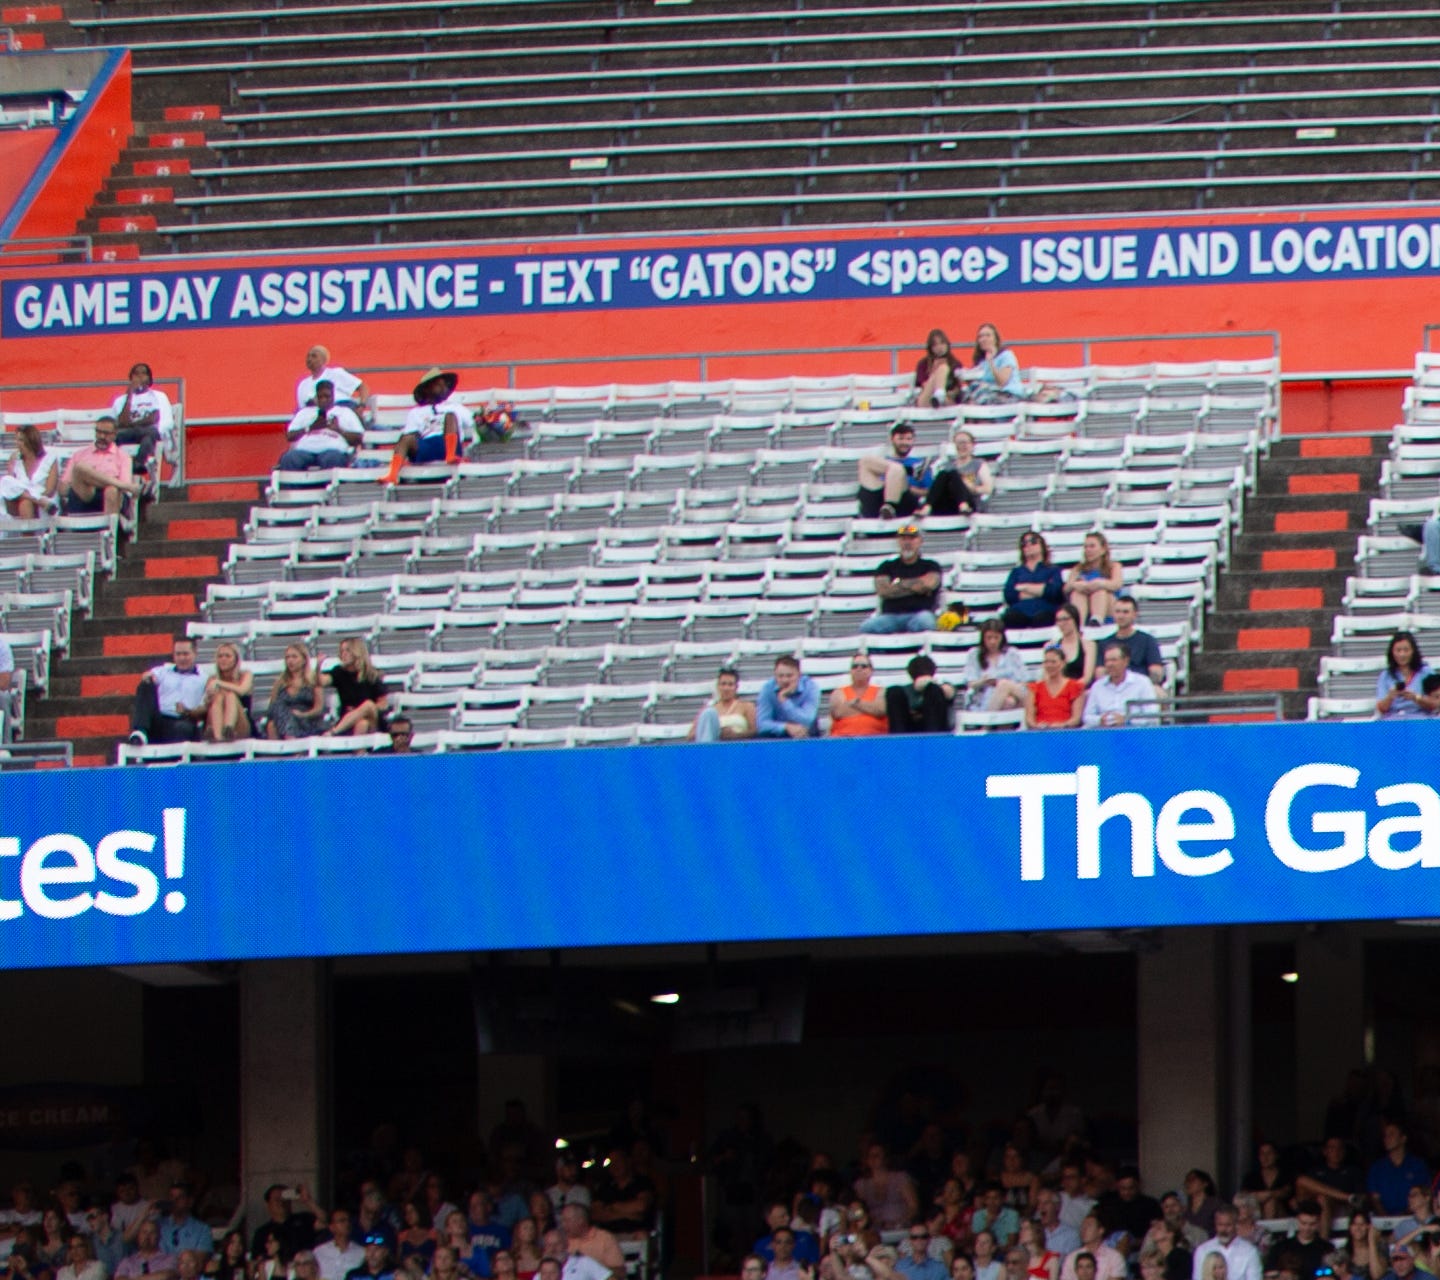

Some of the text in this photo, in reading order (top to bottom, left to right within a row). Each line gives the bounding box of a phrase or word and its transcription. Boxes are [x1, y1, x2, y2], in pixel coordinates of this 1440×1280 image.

[14, 280, 130, 329] GAME
[141, 276, 221, 323] DAY
[231, 263, 478, 318] ASSISTANCE
[516, 257, 619, 304] TEXT
[848, 247, 1009, 292] <space>
[1021, 235, 1138, 283] ISSUE
[1148, 232, 1238, 278] AND
[985, 765, 1235, 881] The
[30, 1103, 110, 1126] CREAM
